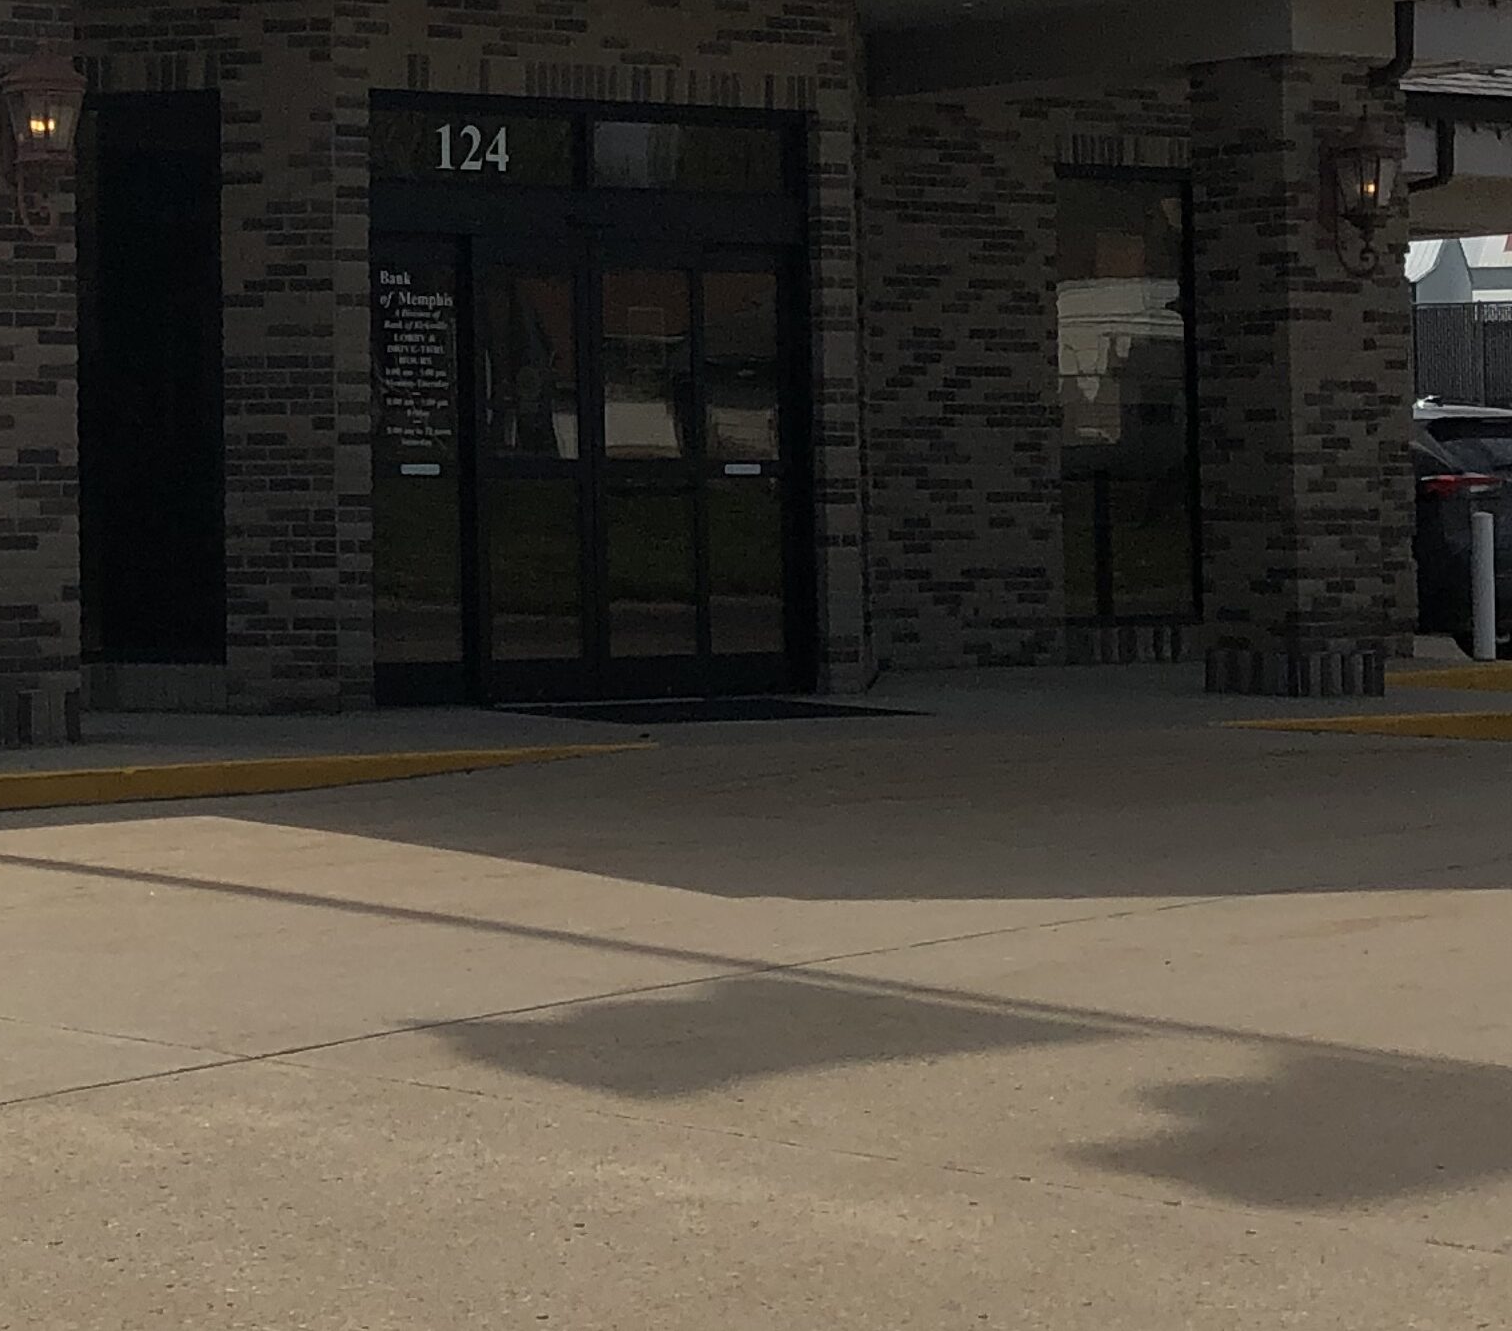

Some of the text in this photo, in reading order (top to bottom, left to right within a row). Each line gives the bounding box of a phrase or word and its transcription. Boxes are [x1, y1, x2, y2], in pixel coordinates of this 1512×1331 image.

[434, 123, 510, 172] 124
[379, 270, 412, 285] Bank
[379, 290, 454, 310] of Memphis
